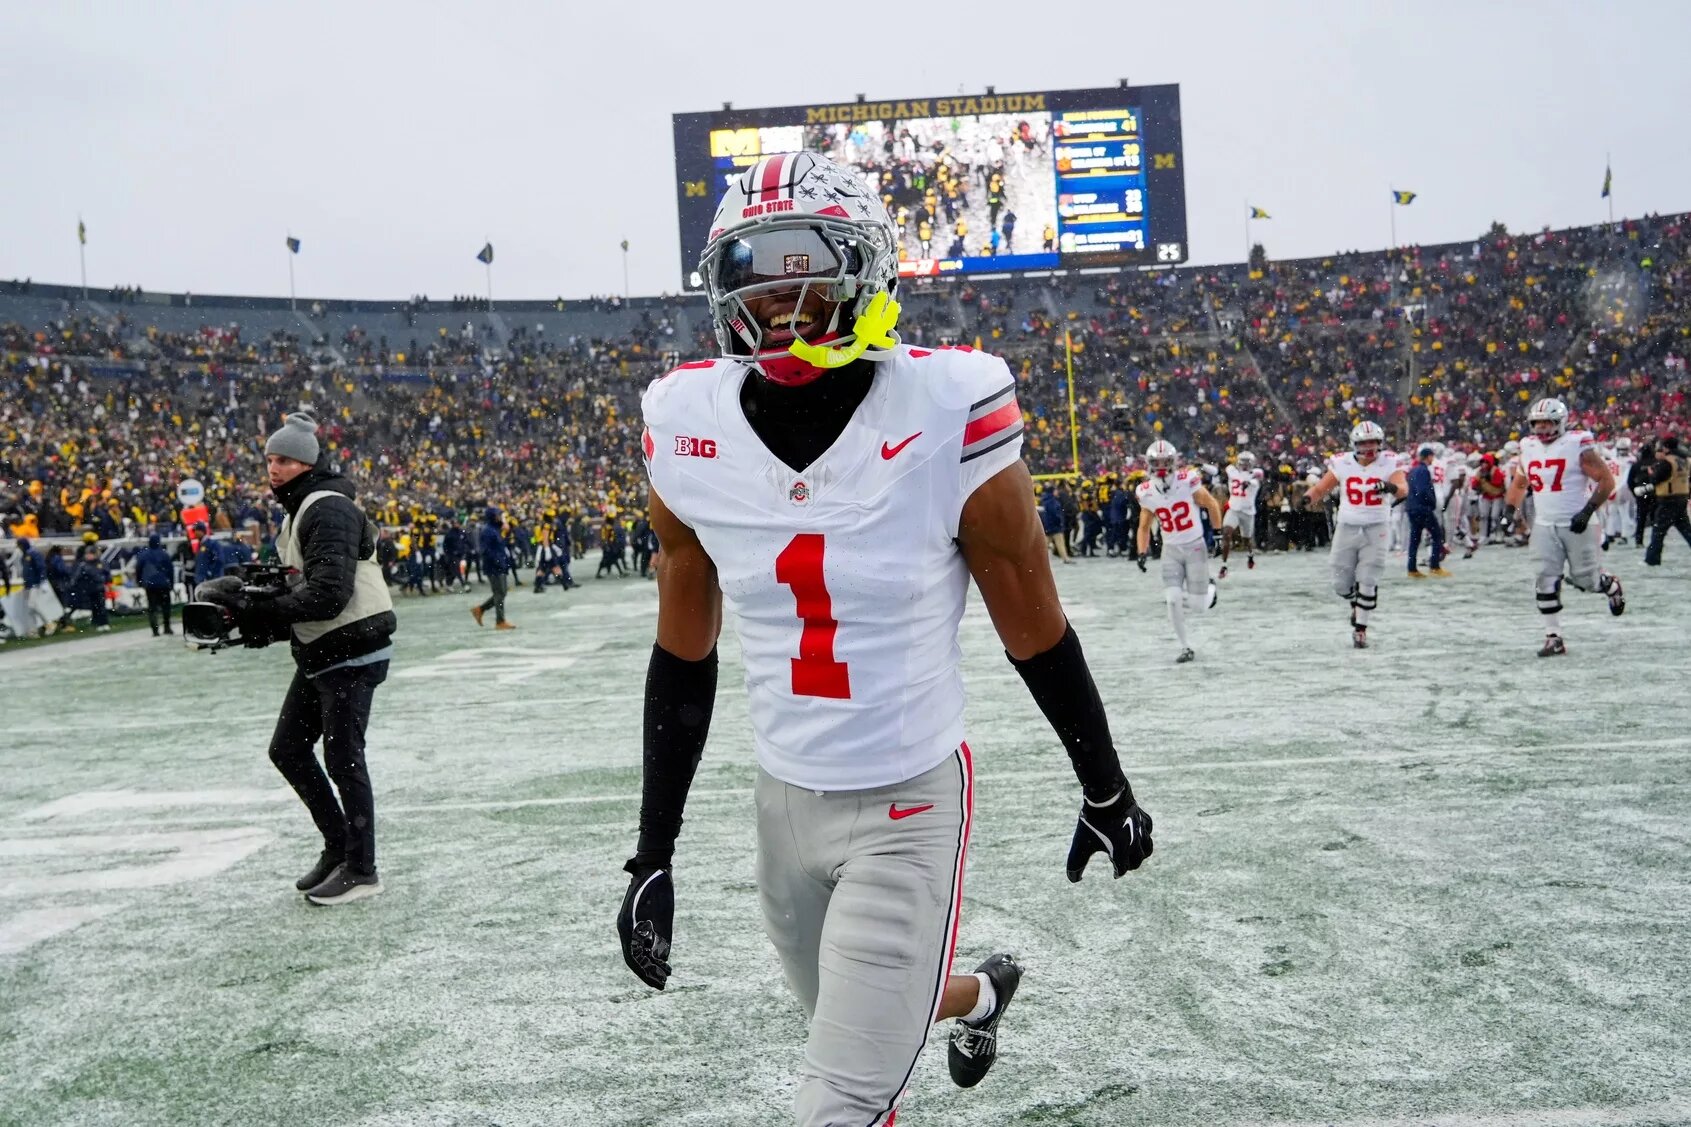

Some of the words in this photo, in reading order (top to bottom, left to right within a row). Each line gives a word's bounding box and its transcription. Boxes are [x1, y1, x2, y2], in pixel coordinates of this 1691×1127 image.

[806, 102, 930, 124] MICHIGAN
[936, 95, 1046, 117] STADIUM
[742, 204, 764, 218] OHIO
[766, 199, 794, 214] STATE
[1158, 244, 1180, 260] 25
[730, 319, 746, 334] ATE
[1528, 458, 1566, 492] 67
[1346, 476, 1383, 506] 62
[1155, 501, 1194, 533] 82
[775, 533, 852, 699] 1
